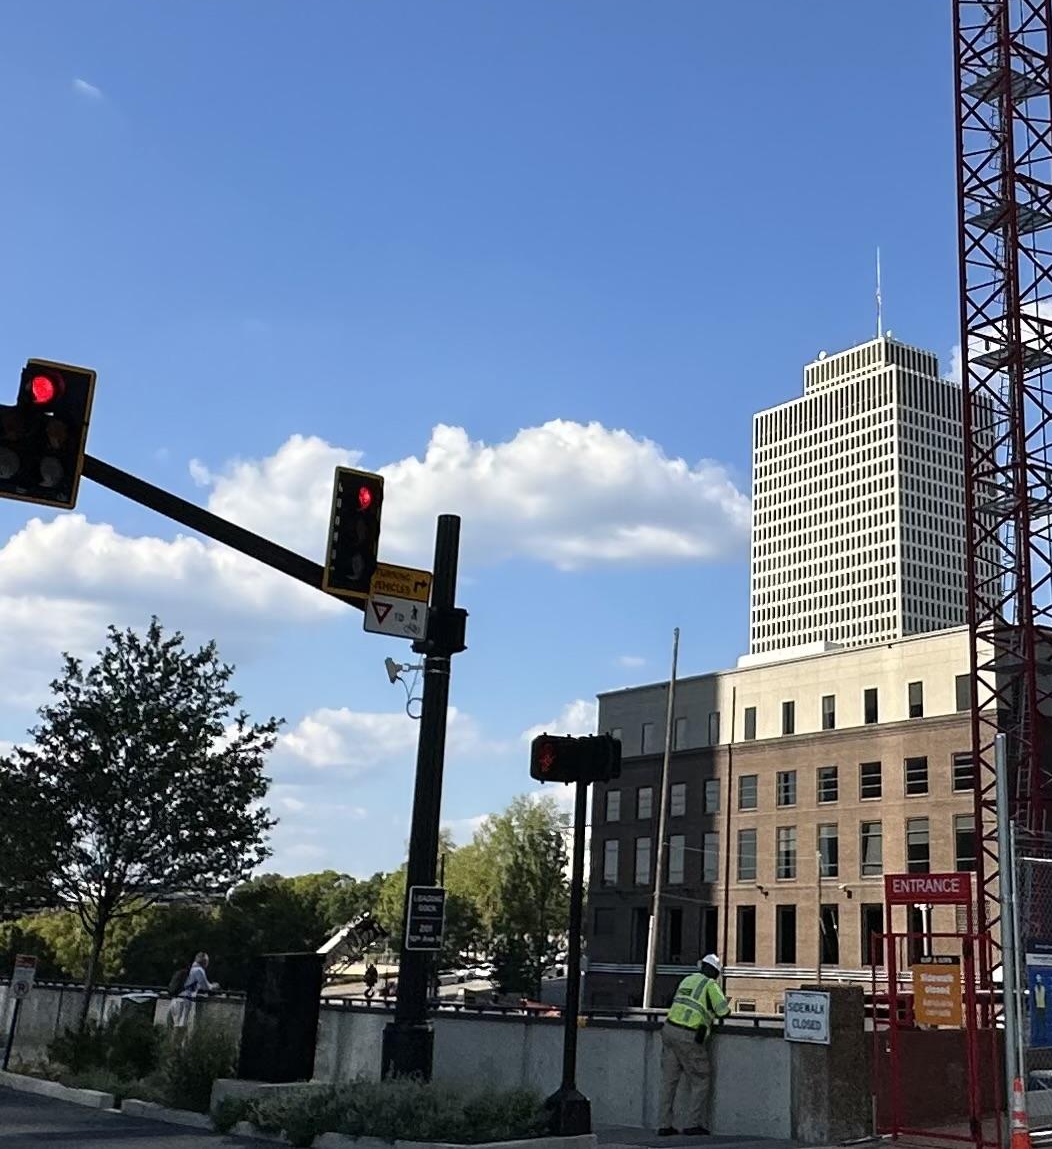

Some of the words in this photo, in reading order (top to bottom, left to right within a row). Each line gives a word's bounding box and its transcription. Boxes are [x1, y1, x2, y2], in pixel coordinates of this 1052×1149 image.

[892, 878, 960, 893] ENTRANCE
[788, 1002, 825, 1014] SIDEWALK
[792, 1018, 822, 1031] CLOSED
